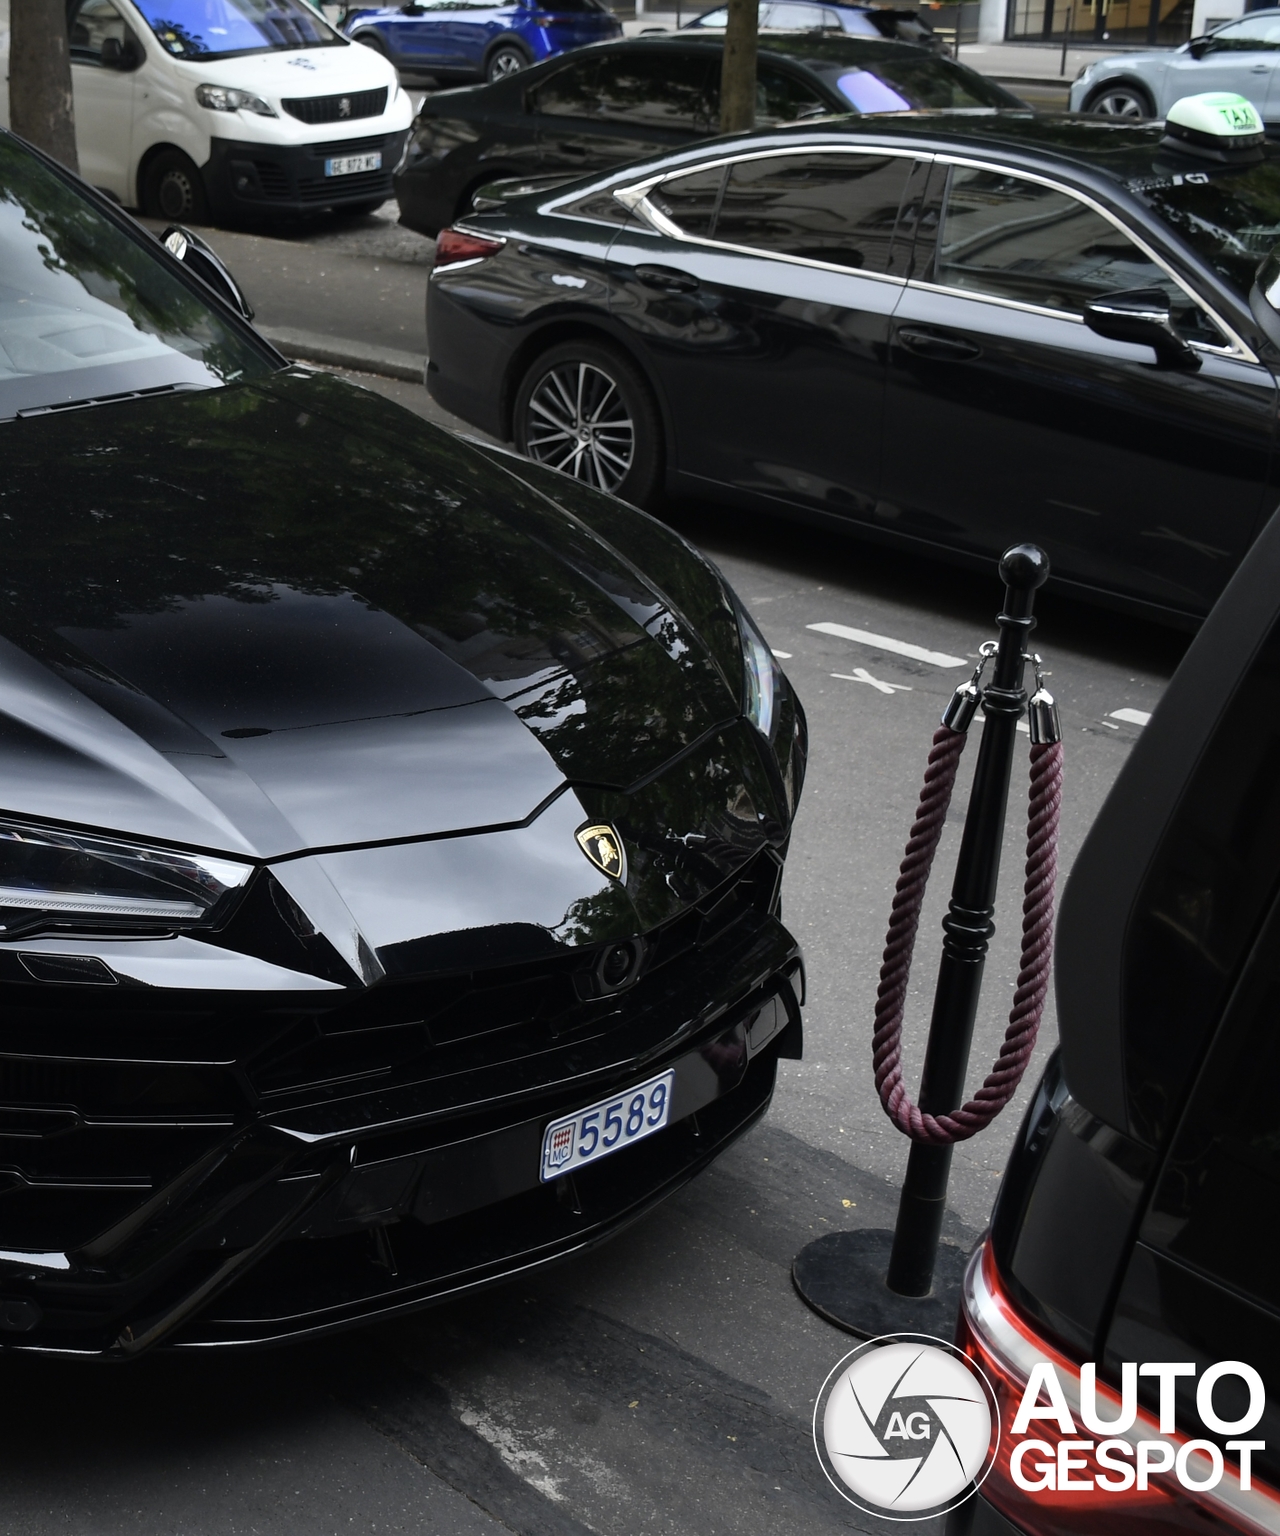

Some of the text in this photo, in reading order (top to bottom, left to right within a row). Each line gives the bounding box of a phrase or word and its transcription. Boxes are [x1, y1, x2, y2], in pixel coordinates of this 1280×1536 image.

[1219, 107, 1257, 125] TAXI
[578, 1082, 668, 1157] 5589
[552, 1145, 569, 1162] MC
